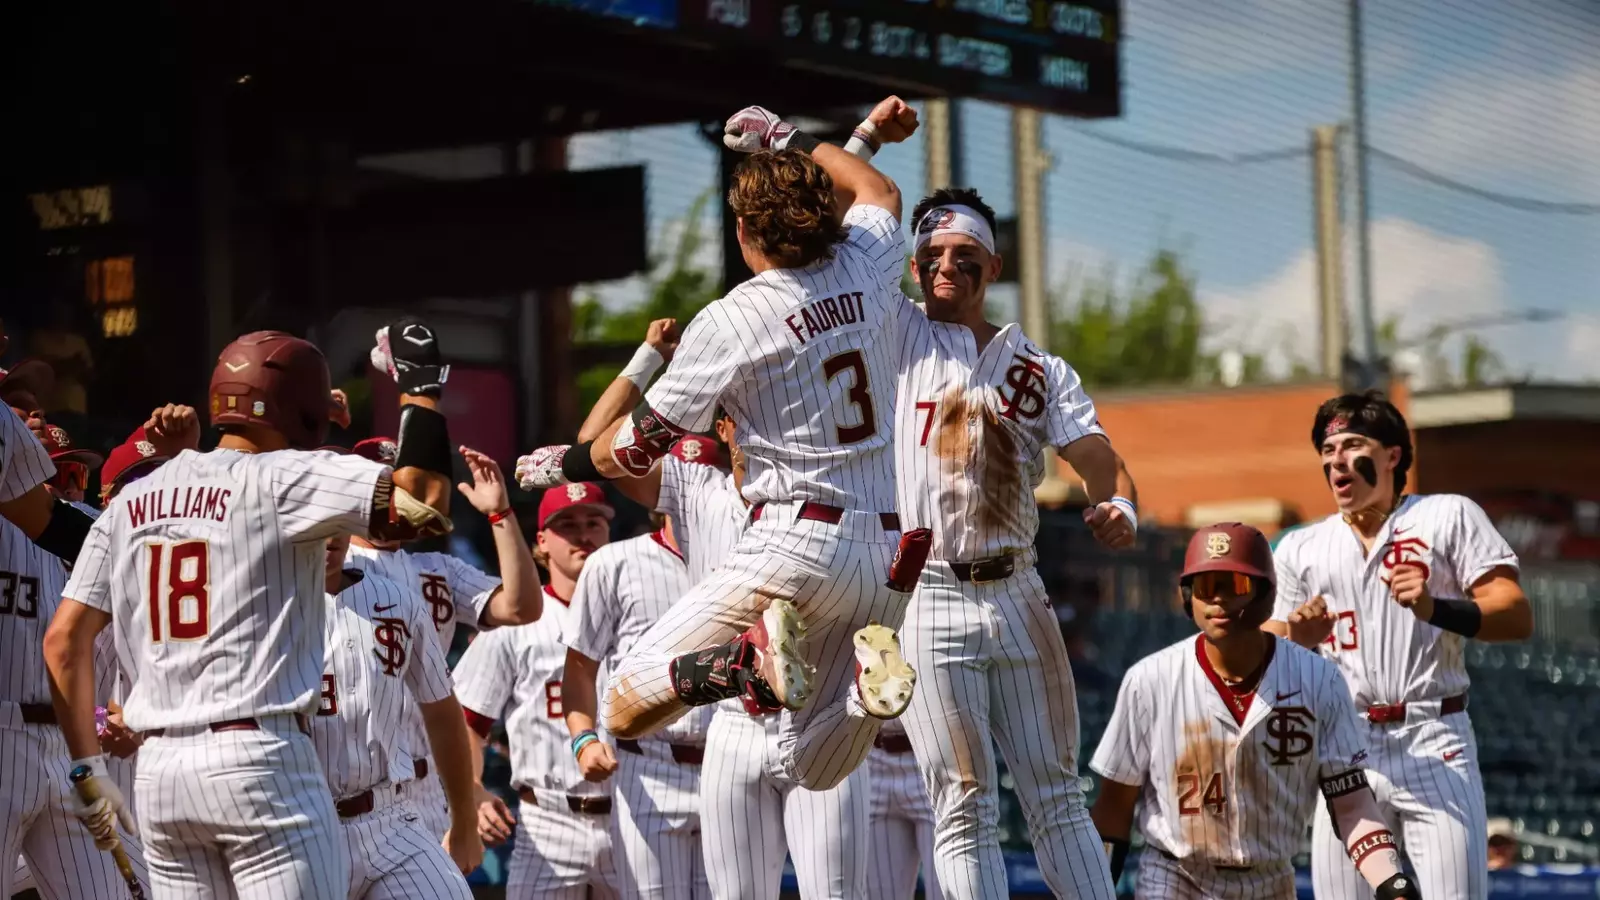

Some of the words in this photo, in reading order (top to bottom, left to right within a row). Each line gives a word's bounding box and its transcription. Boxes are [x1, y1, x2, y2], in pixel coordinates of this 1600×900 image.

[785, 291, 865, 344] FAUROT
[823, 349, 877, 446] 3
[915, 401, 937, 447] 7
[127, 486, 232, 529] WILLIAMS
[0, 571, 39, 618] 33
[144, 539, 211, 645] 18
[1177, 773, 1226, 815] 24
